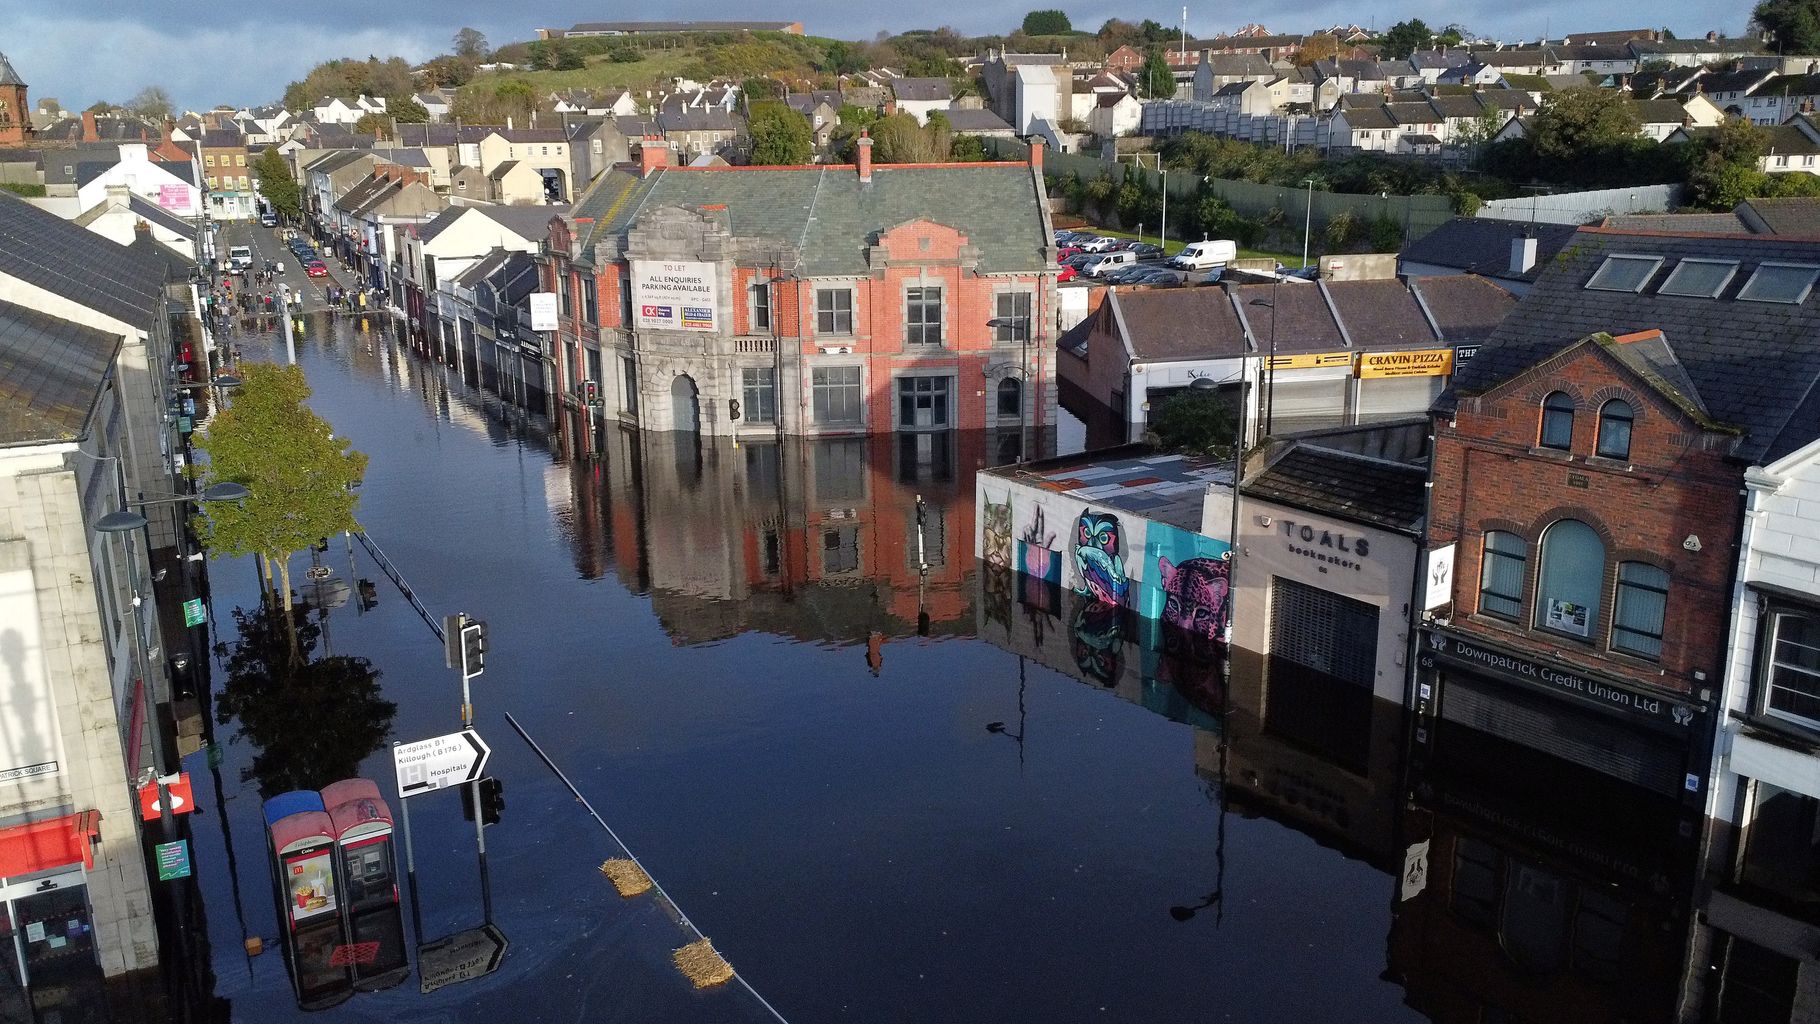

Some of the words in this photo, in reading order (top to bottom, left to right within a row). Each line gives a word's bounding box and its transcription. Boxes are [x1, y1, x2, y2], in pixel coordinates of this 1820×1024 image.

[1370, 355, 1410, 365] CRAVIN
[1413, 354, 1444, 362] PIZZA
[1284, 520, 1369, 556] TOALS
[1288, 544, 1361, 572] bookmakers
[1421, 656, 1433, 668] 68
[1457, 641, 1536, 676] Downpatrick
[1540, 668, 1583, 690] Credit
[1588, 682, 1628, 705] Union
[1634, 695, 1658, 714] Ltd
[397, 743, 432, 755] Ardglass
[398, 752, 431, 764] Killough
[24, 765, 50, 774] SQUARE
[430, 764, 467, 776] Hospitals
